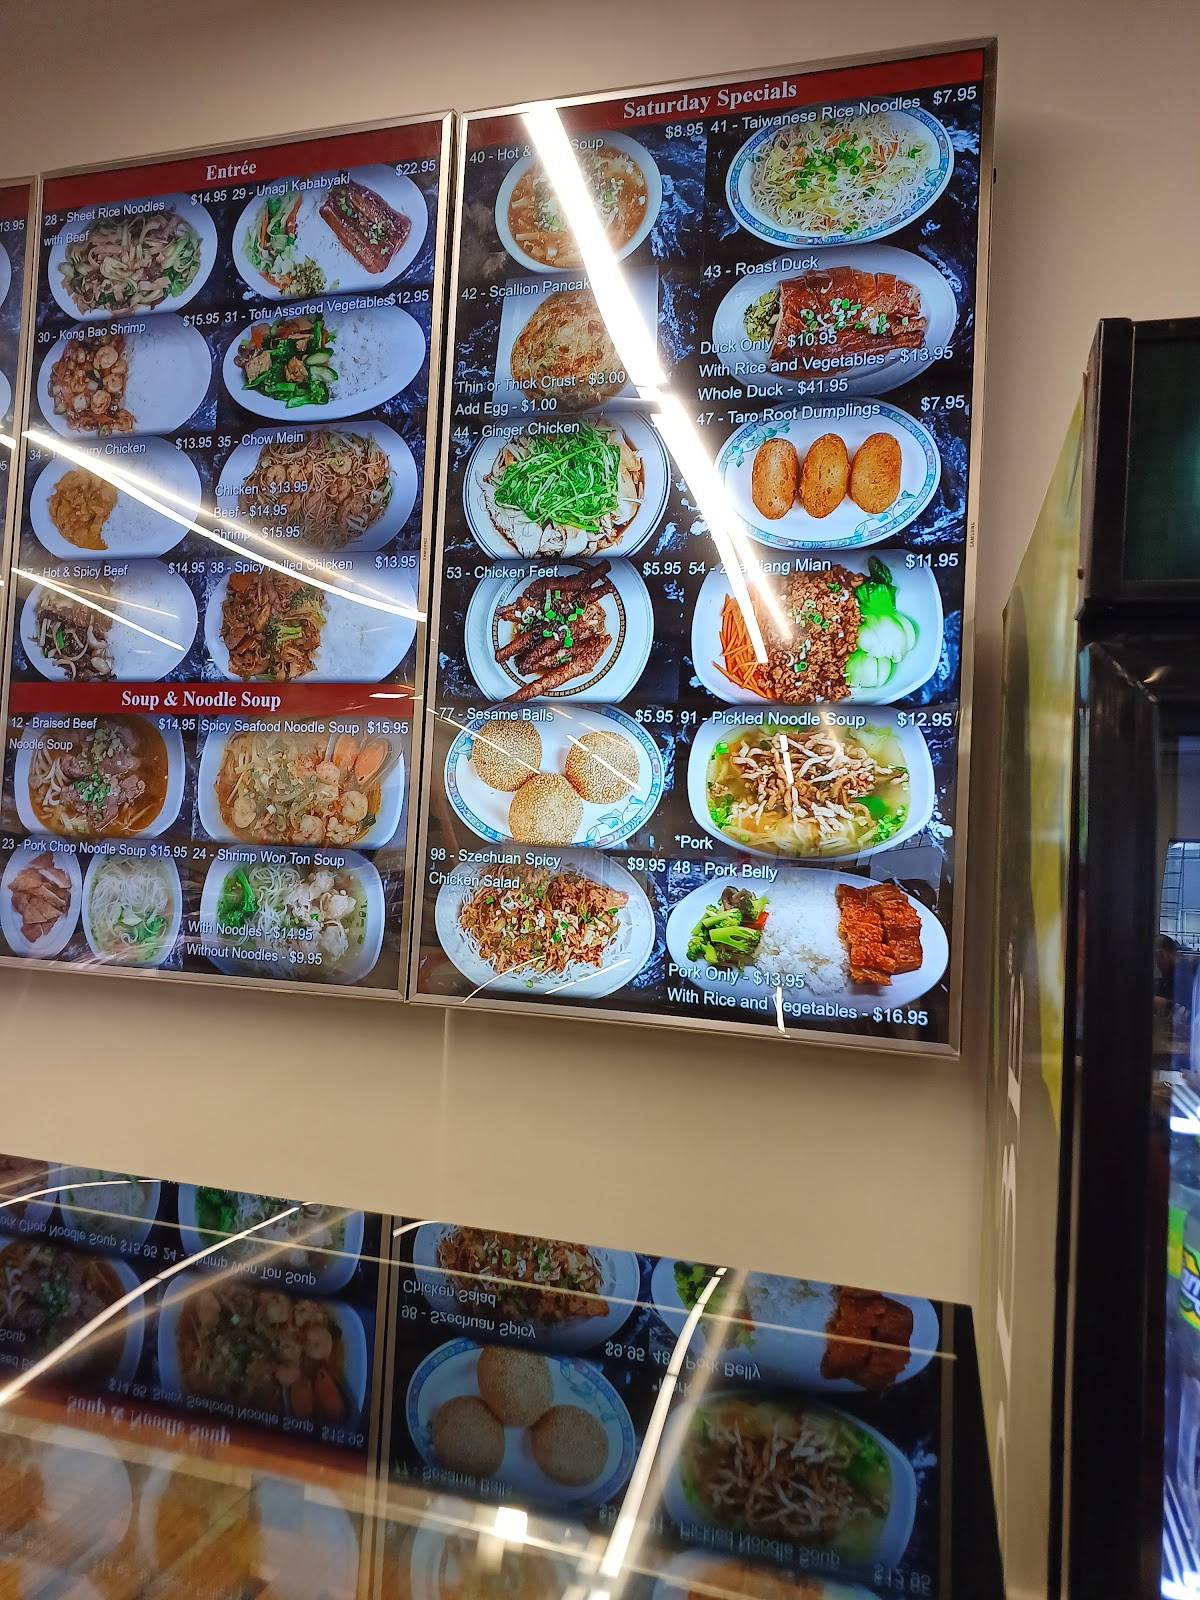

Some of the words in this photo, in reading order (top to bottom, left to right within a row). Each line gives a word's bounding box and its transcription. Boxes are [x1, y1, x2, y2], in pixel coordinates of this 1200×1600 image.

[623, 95, 712, 121] Saturday
[716, 82, 797, 108] Specials
[933, 87, 976, 106] $7.95
[711, 121, 728, 134] 41
[741, 110, 817, 130] Taiwanese
[821, 105, 854, 120] Rice
[857, 95, 921, 116] Noodles
[665, 122, 704, 140] $8.95
[470, 151, 486, 163] 40
[497, 146, 520, 161] Hot
[522, 144, 533, 157] &
[570, 137, 604, 153] Soup
[206, 160, 257, 181] Entrée
[396, 160, 436, 176] $22.95
[232, 188, 245, 200] 29
[256, 182, 289, 199] Unagi
[292, 173, 350, 193] Kababyaki
[191, 190, 227, 206] $14.95
[45, 214, 58, 226] 28
[66, 208, 96, 224] Sheet
[99, 205, 120, 218] Rice
[123, 200, 165, 216] Noodles
[44, 235, 63, 247] with
[66, 231, 90, 244] Beef
[704, 265, 723, 278] 43
[735, 260, 779, 276] Roast
[782, 255, 819, 271] Duck
[389, 289, 429, 306] $12.95
[462, 286, 477, 300] 42
[489, 280, 539, 296] Scallion
[542, 278, 596, 292] Pancak
[224, 310, 238, 322] 31
[249, 307, 273, 321] Tofu
[275, 302, 323, 318] Assorted
[326, 295, 392, 315] Vegetables
[183, 313, 219, 328] $15.95
[38, 332, 50, 343] 30
[59, 328, 85, 343] Kong
[87, 326, 107, 338] Bao
[109, 322, 146, 338] Shrimp
[700, 339, 736, 355] Duck
[740, 337, 774, 357] Only
[788, 330, 837, 349] $10.95
[699, 363, 732, 378] With
[736, 361, 767, 375] Rice
[771, 357, 799, 373] and
[802, 350, 885, 374] Vegetables
[900, 345, 953, 364] $13.95
[457, 380, 484, 393] Thin
[487, 382, 500, 392] or
[504, 376, 538, 391] Thick
[540, 374, 576, 389] Crust
[589, 369, 626, 387] $3.00
[698, 386, 742, 401] Whole
[747, 383, 783, 398] Duck
[797, 377, 848, 396] $41.95
[455, 402, 480, 415] Add
[483, 400, 509, 417] Egg
[521, 397, 557, 414] $1.00
[920, 395, 965, 413] $7.95
[696, 412, 713, 425] 47
[728, 409, 760, 423] Taro
[764, 406, 798, 421] Root
[801, 402, 881, 423] Dumplings
[218, 436, 232, 448] 35
[242, 434, 274, 446] Chow
[276, 431, 304, 444] Mein
[454, 425, 470, 438] 44
[482, 422, 525, 440] Ginger
[528, 421, 581, 436] Chicken
[30, 450, 42, 461] 34
[105, 442, 146, 456] Chicken
[176, 436, 212, 450] $13.95
[215, 483, 259, 496] Chicken
[270, 480, 308, 495] $13.95
[214, 506, 240, 518] Beef
[250, 504, 288, 518] $14.95
[262, 526, 300, 540] $15.95
[168, 562, 205, 575] $14.95
[210, 562, 223, 573] 38
[235, 560, 265, 575] Spicy
[306, 558, 353, 571] Chicken
[375, 555, 416, 569] $13.95
[643, 560, 681, 577] $5.95
[689, 561, 705, 575] 54
[795, 558, 832, 572] Mian
[906, 552, 959, 570] $11.95
[44, 566, 60, 578] Hot
[63, 566, 70, 577] &
[74, 566, 101, 579] Spicy
[104, 564, 128, 576] Beef
[446, 565, 463, 579] 53
[474, 564, 525, 579] Chicken
[529, 564, 559, 578] Feet
[122, 691, 160, 709] Soup
[163, 692, 178, 706] &
[182, 691, 237, 708] Noodle
[241, 693, 281, 710] Soup
[11, 718, 23, 728] 12
[32, 717, 69, 729] Braised
[73, 718, 97, 729] Beef
[439, 707, 454, 721] 77
[467, 708, 518, 721] Sesame
[522, 708, 554, 722] Balls
[634, 707, 674, 725] $5.95
[680, 711, 696, 725] 91
[712, 710, 764, 726] Pickled
[768, 711, 821, 726] Noodle
[825, 711, 865, 729] Soup
[897, 711, 952, 728] $12.95
[158, 719, 195, 732] $14.95
[201, 720, 231, 734] Spicy
[234, 720, 281, 732] Seafood
[284, 721, 326, 733] Noodle
[329, 722, 360, 735] Soup
[367, 721, 408, 735] $15.95
[9, 739, 45, 750] Noodle
[47, 740, 73, 752] Soup
[2, 838, 15, 849] 23
[24, 840, 47, 852] Pork
[50, 842, 77, 856] Chop
[79, 843, 116, 856] Noodle
[118, 845, 147, 859] Soup
[150, 845, 187, 858] $15.95
[193, 848, 206, 860] 24
[218, 849, 257, 865] Shrimp
[260, 851, 287, 864] Won
[290, 853, 311, 866] Ton
[314, 854, 345, 869] Soup
[430, 848, 446, 861] 98
[458, 849, 522, 866] Szechuan
[525, 852, 561, 870] Spicy
[627, 856, 666, 873] $9.95
[429, 872, 480, 888] Chicken
[483, 874, 520, 889] Salad
[673, 860, 690, 874] 48
[705, 862, 738, 877] Pork
[741, 863, 778, 883] Belly
[188, 920, 212, 934] With
[215, 922, 262, 937] Noodles
[273, 927, 313, 941] $14.95
[187, 943, 229, 958] Without
[232, 946, 278, 962] Noodles
[289, 951, 322, 965] $9.95
[669, 963, 702, 980] Pork
[705, 967, 740, 987] Only
[753, 969, 805, 989] $13.95
[667, 987, 701, 1006] With
[704, 990, 735, 1008] Rice
[740, 994, 768, 1010] and
[872, 1006, 929, 1027] $16.95
